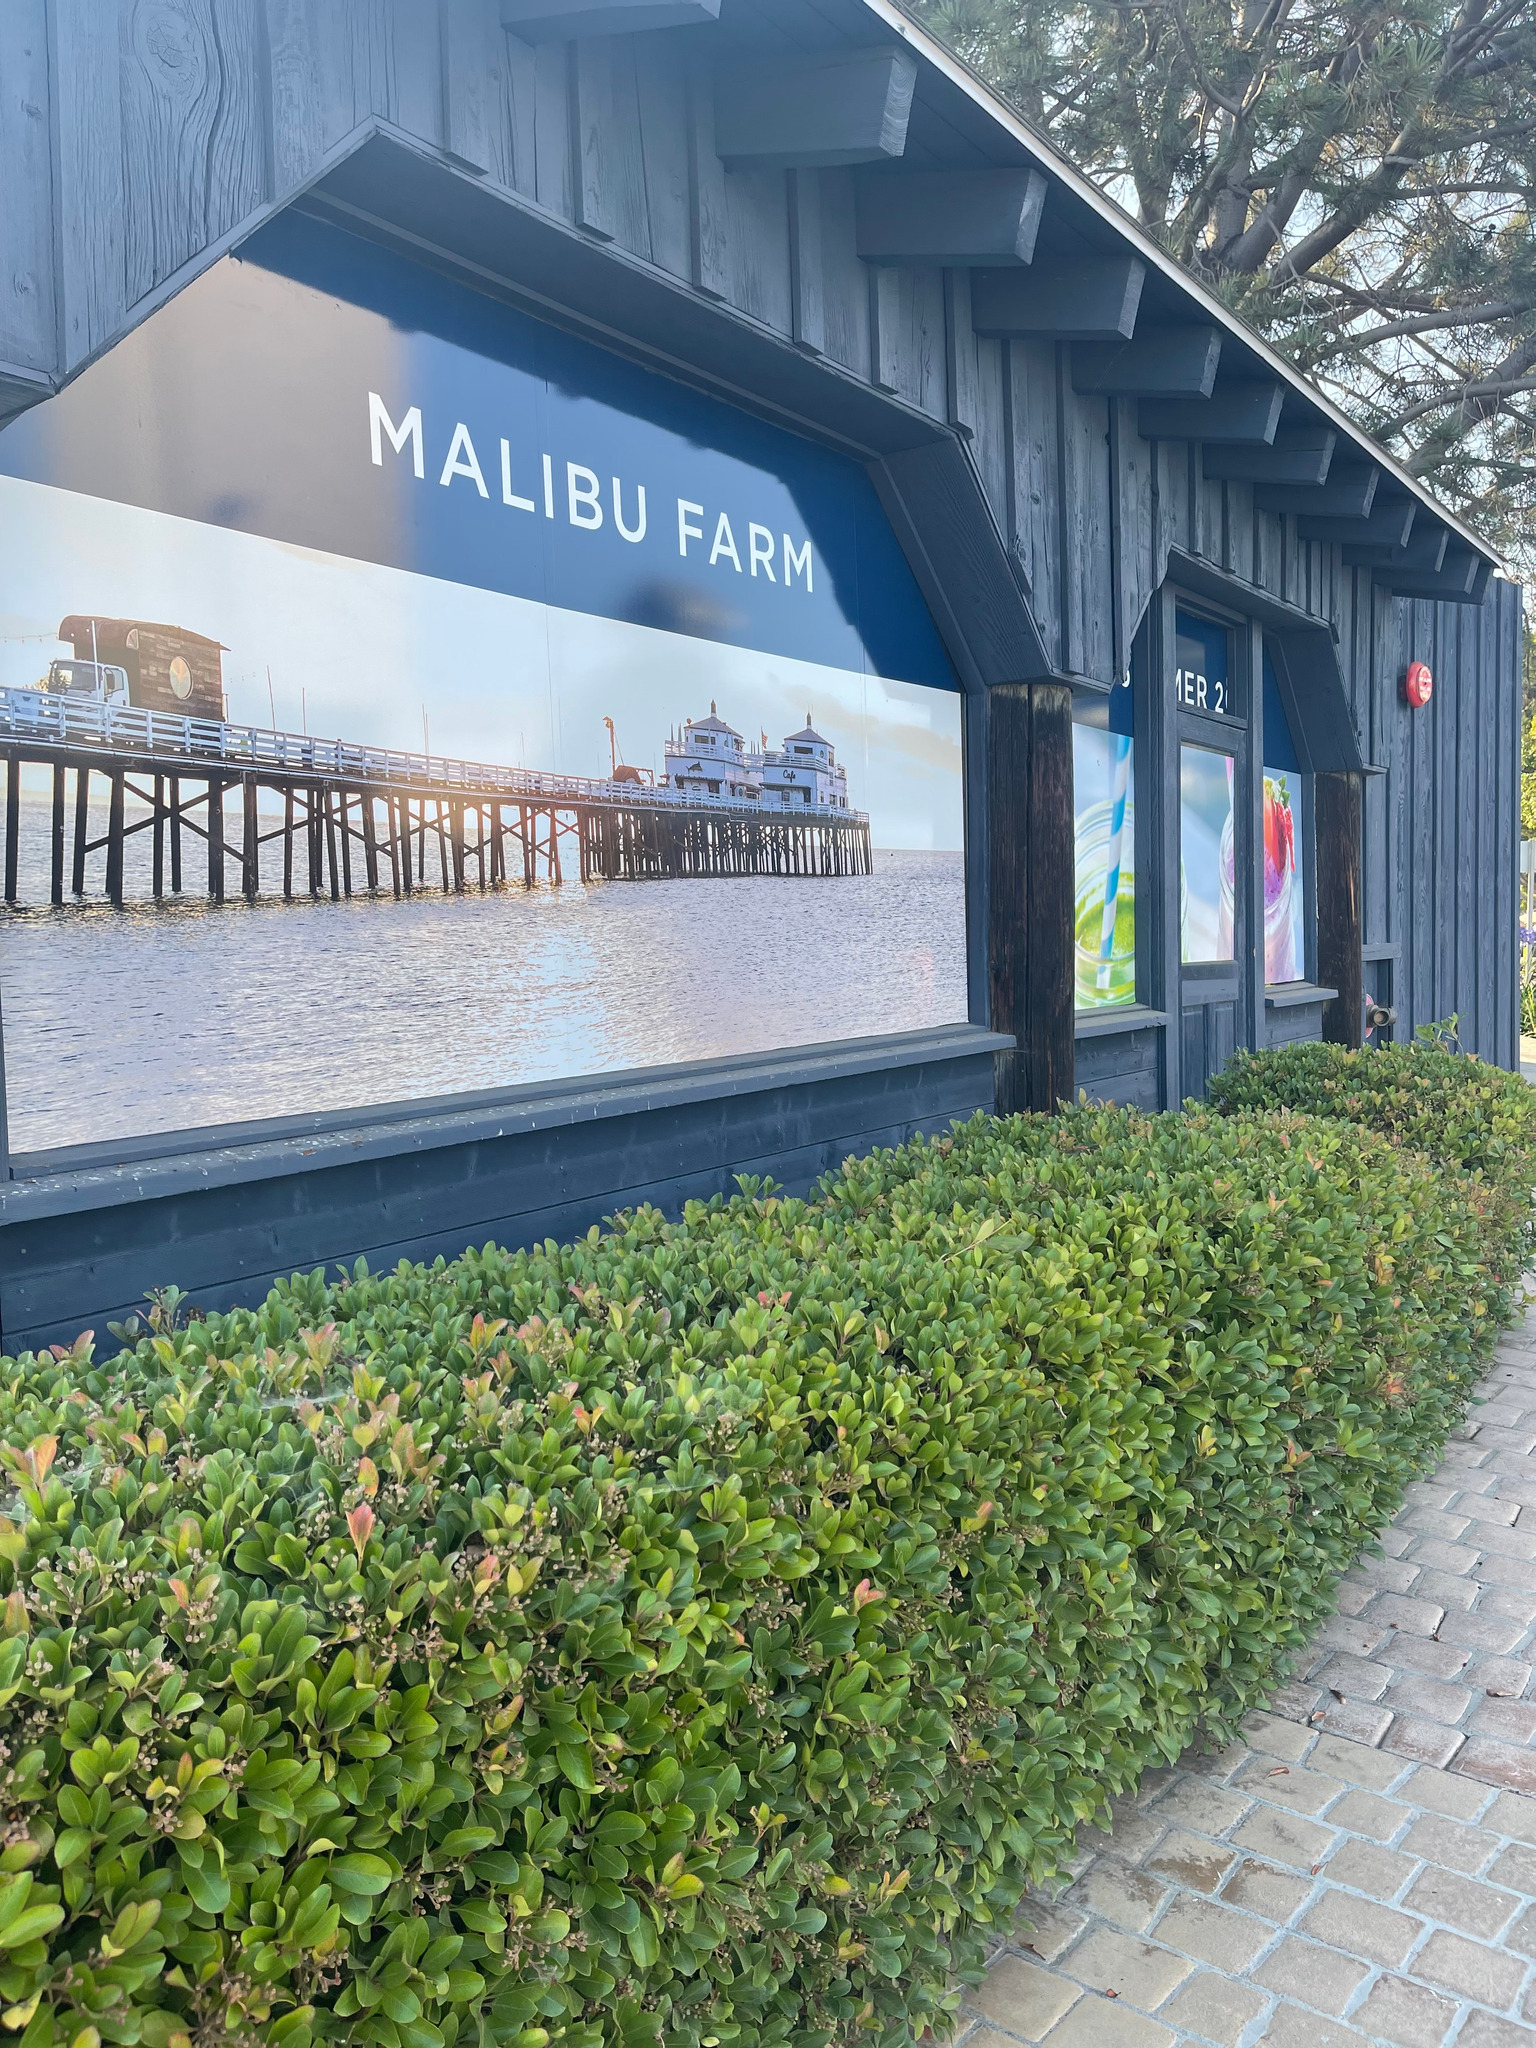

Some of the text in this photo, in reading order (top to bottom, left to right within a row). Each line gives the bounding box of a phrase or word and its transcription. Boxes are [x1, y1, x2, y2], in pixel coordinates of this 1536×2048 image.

[368, 391, 814, 593] MALIBU FARM
[1215, 680, 1228, 714] 2
